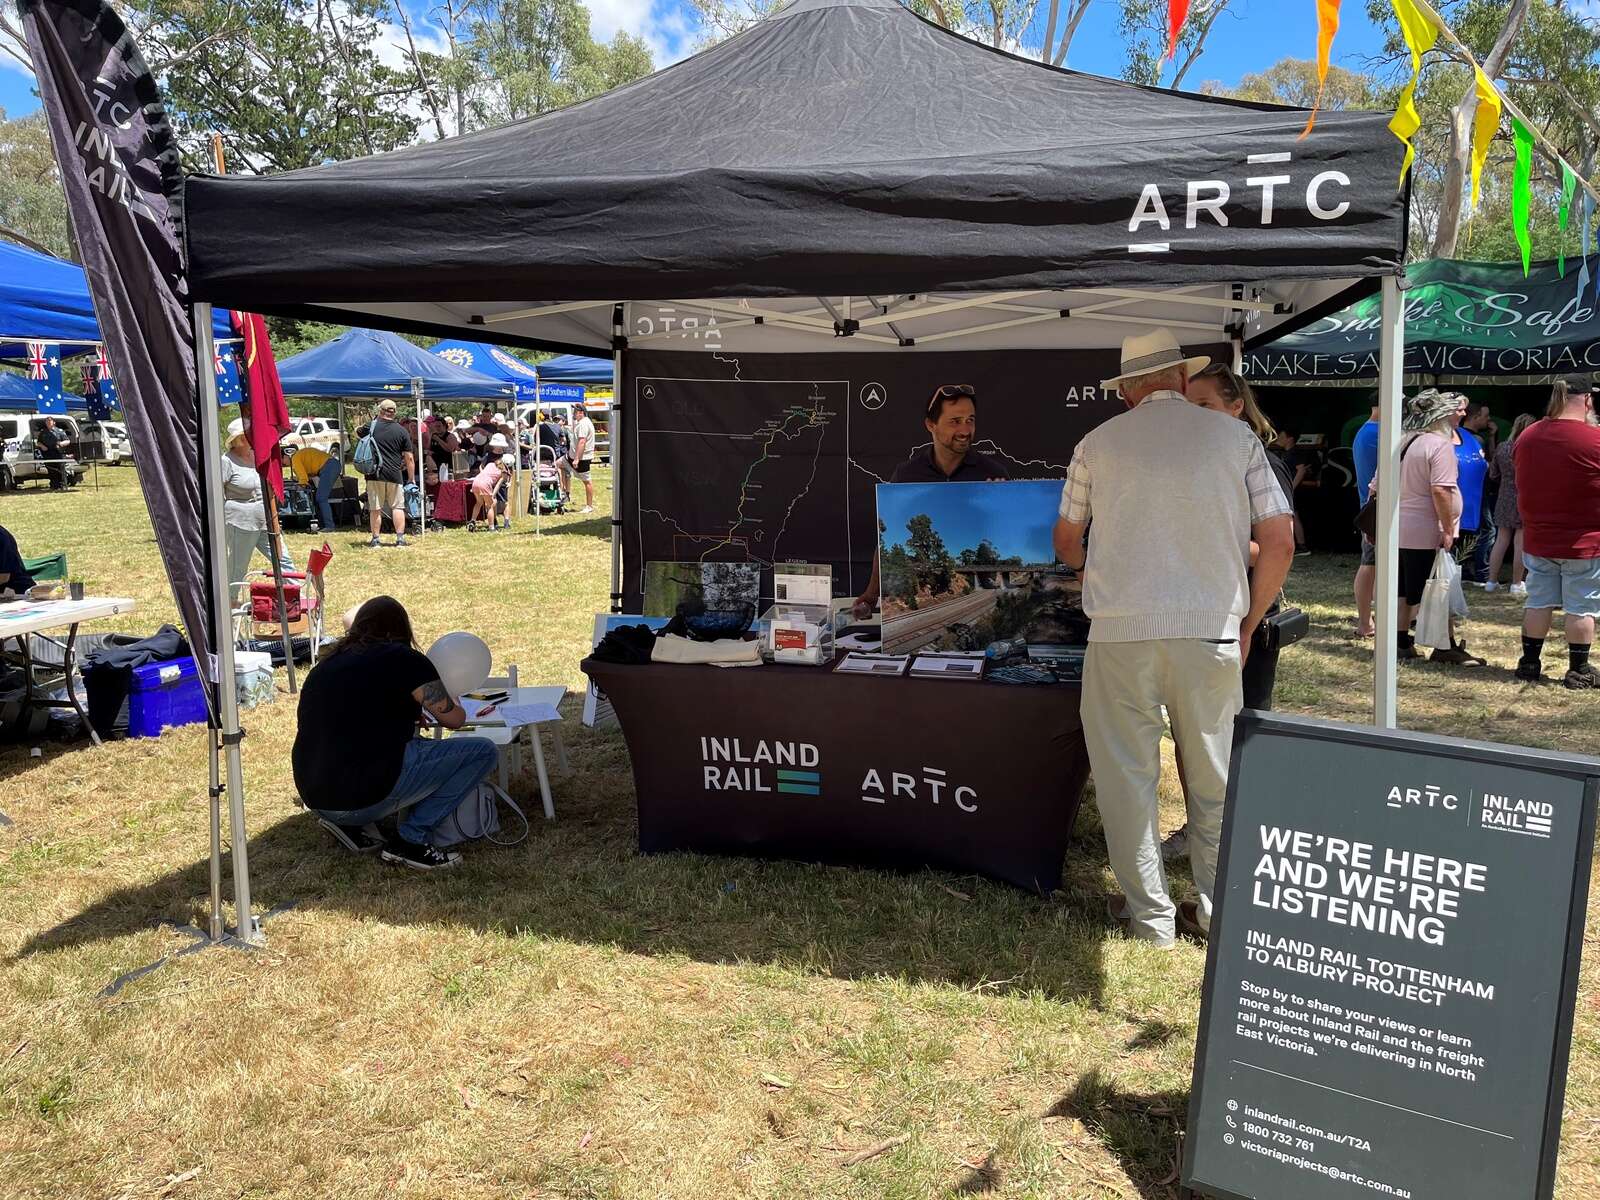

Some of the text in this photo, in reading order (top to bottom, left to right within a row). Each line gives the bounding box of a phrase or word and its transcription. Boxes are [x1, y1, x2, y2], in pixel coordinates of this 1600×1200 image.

[1128, 152, 1350, 253] ARTC
[1345, 318, 1517, 342] VITORIA
[1455, 293, 1594, 336] Safe
[1241, 345, 1600, 376] SNAKESAEVICTORIA.C
[701, 736, 819, 767] INLAND
[703, 766, 771, 792] RAIL
[862, 766, 978, 813] ARTC
[1387, 784, 1458, 810] ARTC
[1481, 808, 1523, 828] RAIL
[1483, 793, 1553, 817] INLAND
[1260, 824, 1488, 892] WE'RE HERE
[1254, 854, 1460, 917] AND WE'RE
[1252, 880, 1445, 945] LISTENING
[1245, 945, 1447, 1006] TO ALBURY PROJECT
[1246, 929, 1494, 1000] INLAND RAIL TOTTENHAM
[1239, 997, 1484, 1067] more about Inland Rail and the freight
[1240, 980, 1472, 1047] Stop by to share your views or learn
[1236, 1024, 1318, 1056] East Victoria.
[1237, 1011, 1476, 1081] rail projects we're delivering in North
[1242, 1122, 1315, 1152] 1800 732 761
[1244, 1105, 1371, 1152] inlandrail.com.au/T2A
[1240, 1140, 1411, 1199] victoriaprojects@artc.com.au
